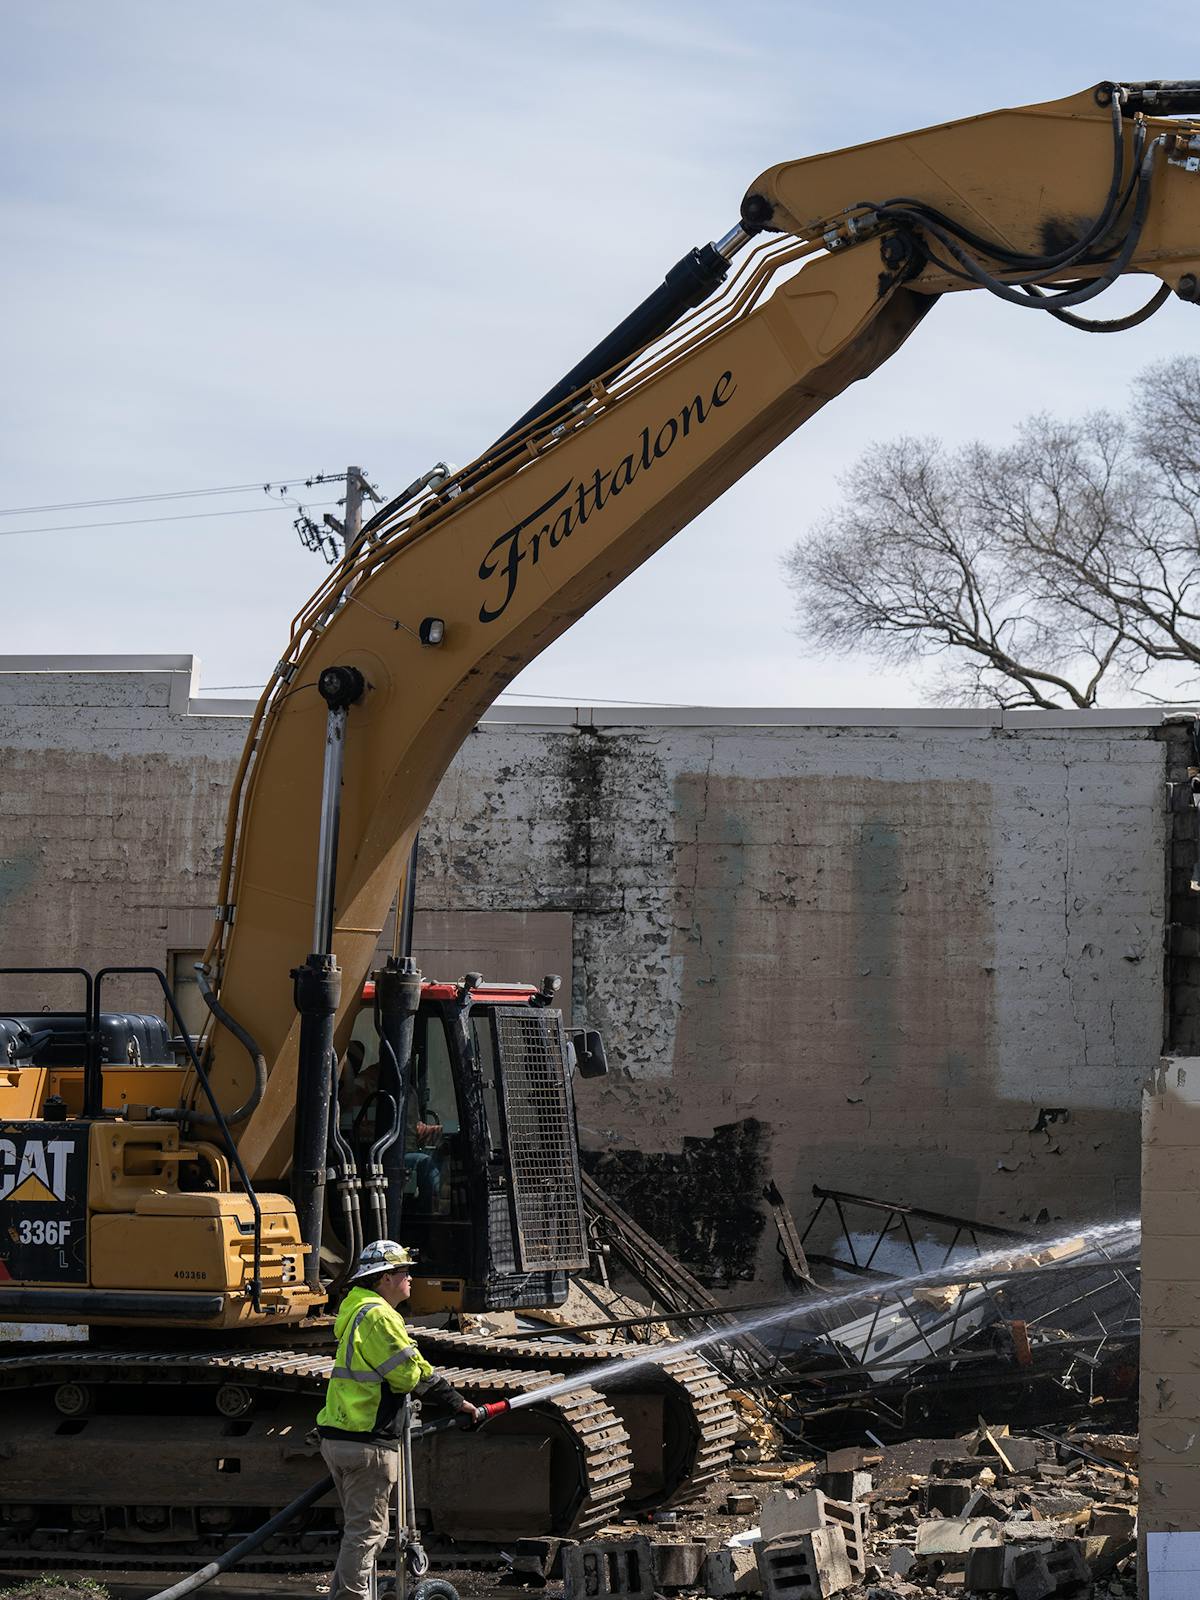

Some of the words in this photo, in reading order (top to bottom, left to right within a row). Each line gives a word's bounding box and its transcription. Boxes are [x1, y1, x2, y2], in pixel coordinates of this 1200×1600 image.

[478, 370, 738, 624] Frattalone
[19, 1220, 71, 1245] 336F
[59, 1250, 69, 1268] L
